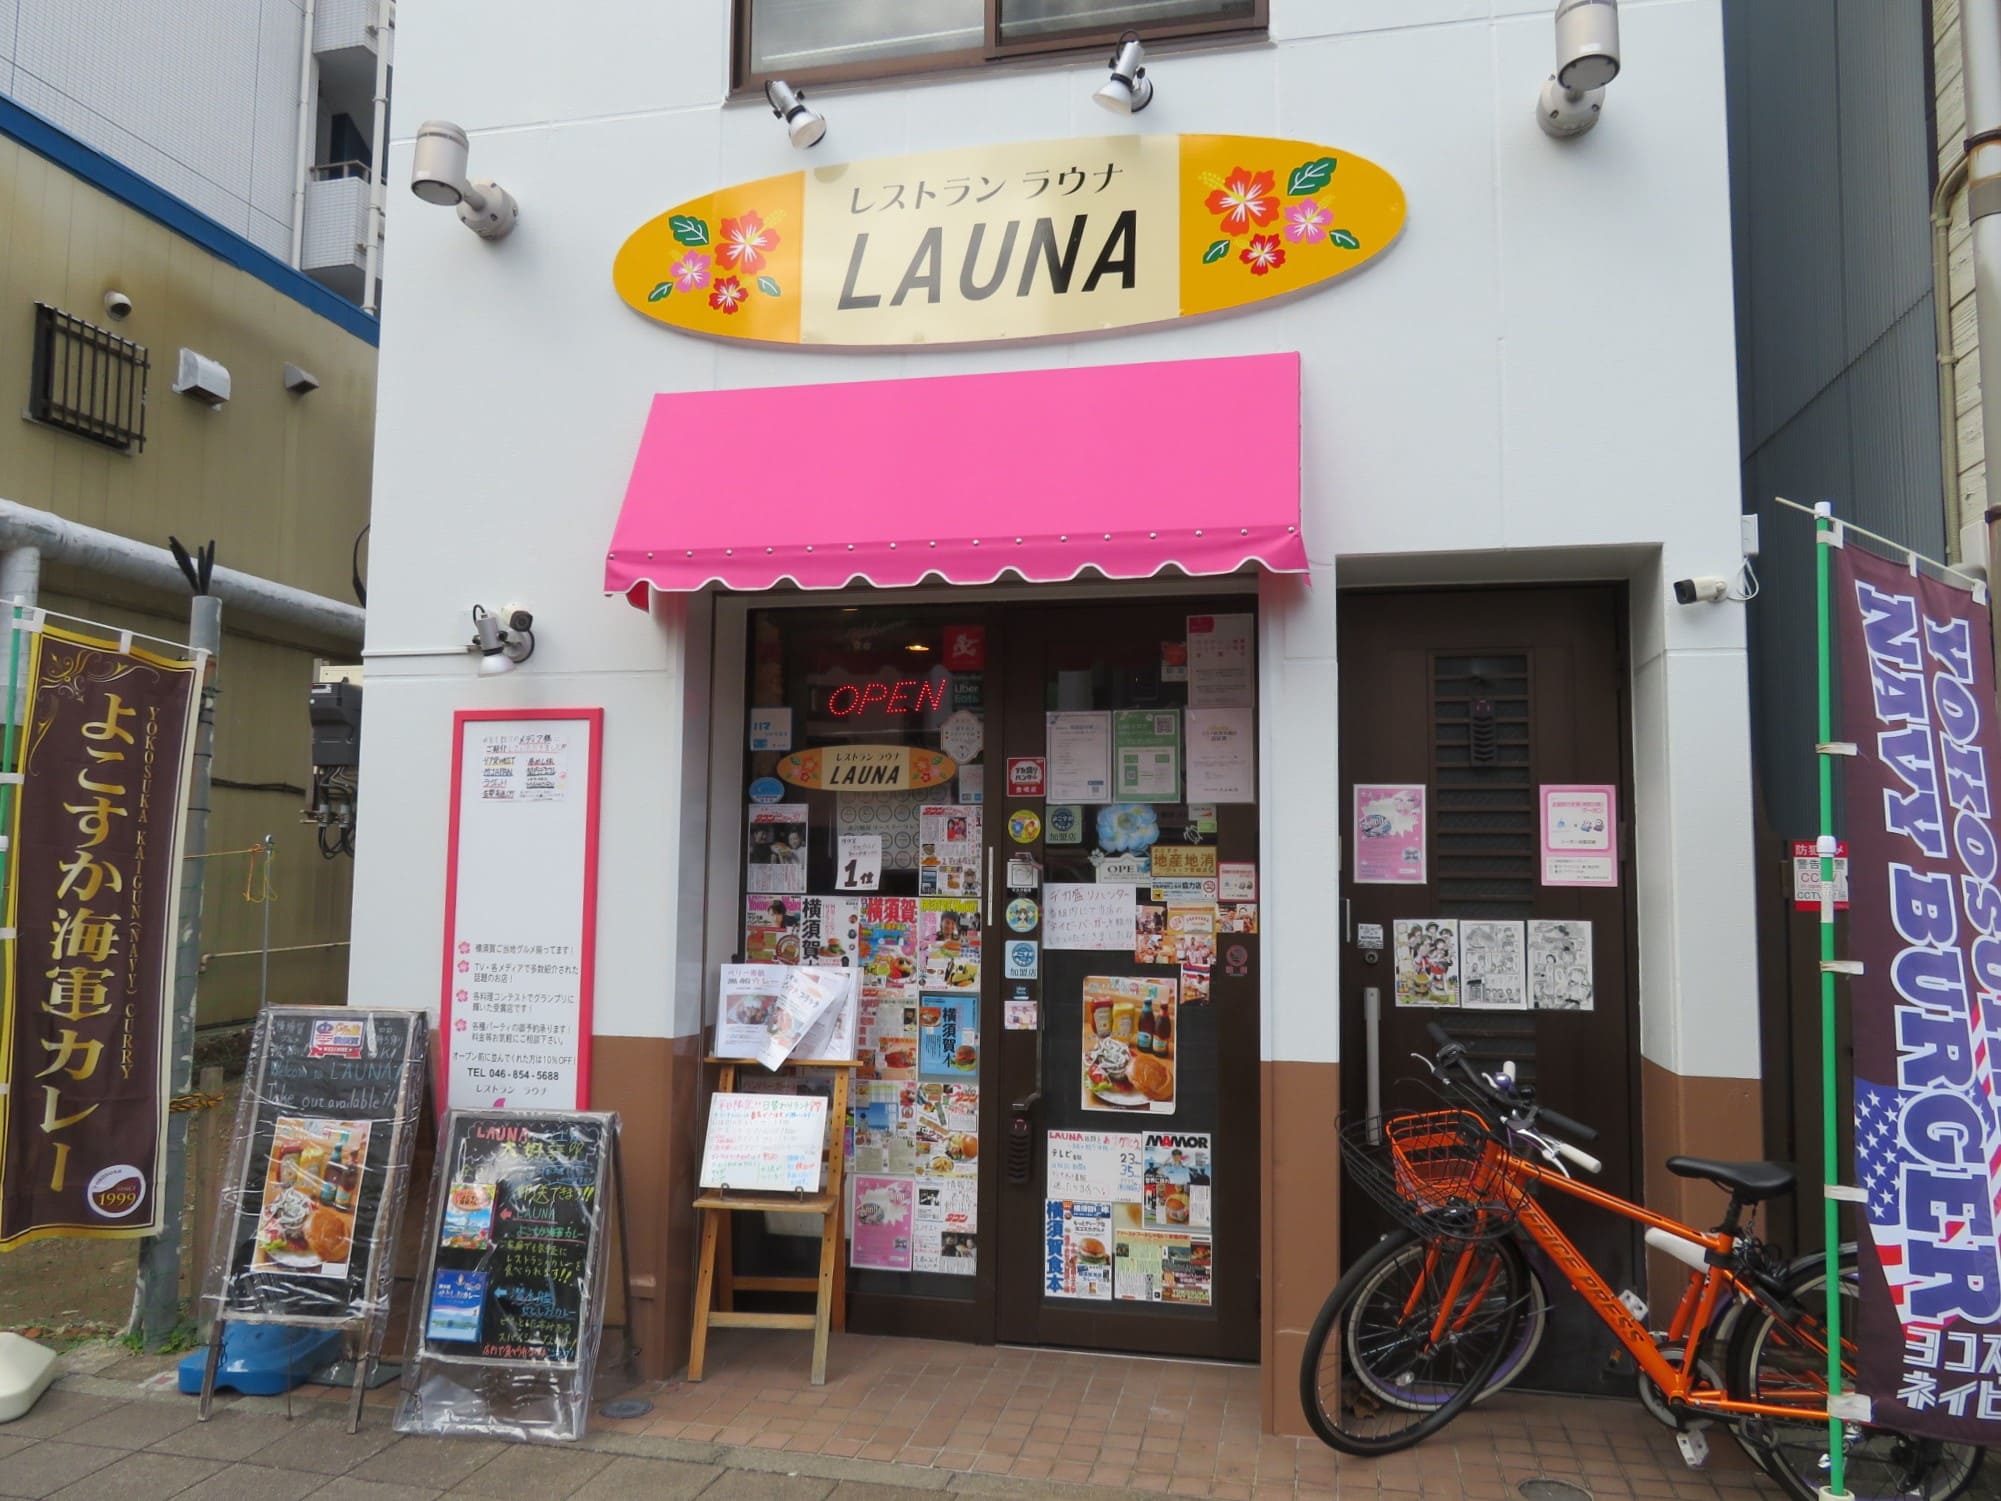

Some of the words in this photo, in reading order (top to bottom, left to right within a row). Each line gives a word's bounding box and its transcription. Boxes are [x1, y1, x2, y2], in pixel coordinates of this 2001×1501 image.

[848, 172, 1008, 215] レストラン
[1023, 162, 1125, 194] ラウナ
[837, 209, 1138, 311] LAUNA
[829, 680, 948, 717] OPEN
[1854, 579, 1948, 859] NAVY
[829, 765, 901, 785] LAUNA
[1153, 853, 1215, 868] 地産地消
[36, 692, 137, 1193] よこすか海軍カレー
[467, 1067, 486, 1078] TEL
[1888, 862, 2001, 1325] BURGER
[1049, 1132, 1084, 1142] LAUNA
[1146, 1134, 1209, 1149] MAMOR
[99, 1193, 136, 1206] 1999
[1577, 1275, 1646, 1344] PRESS
